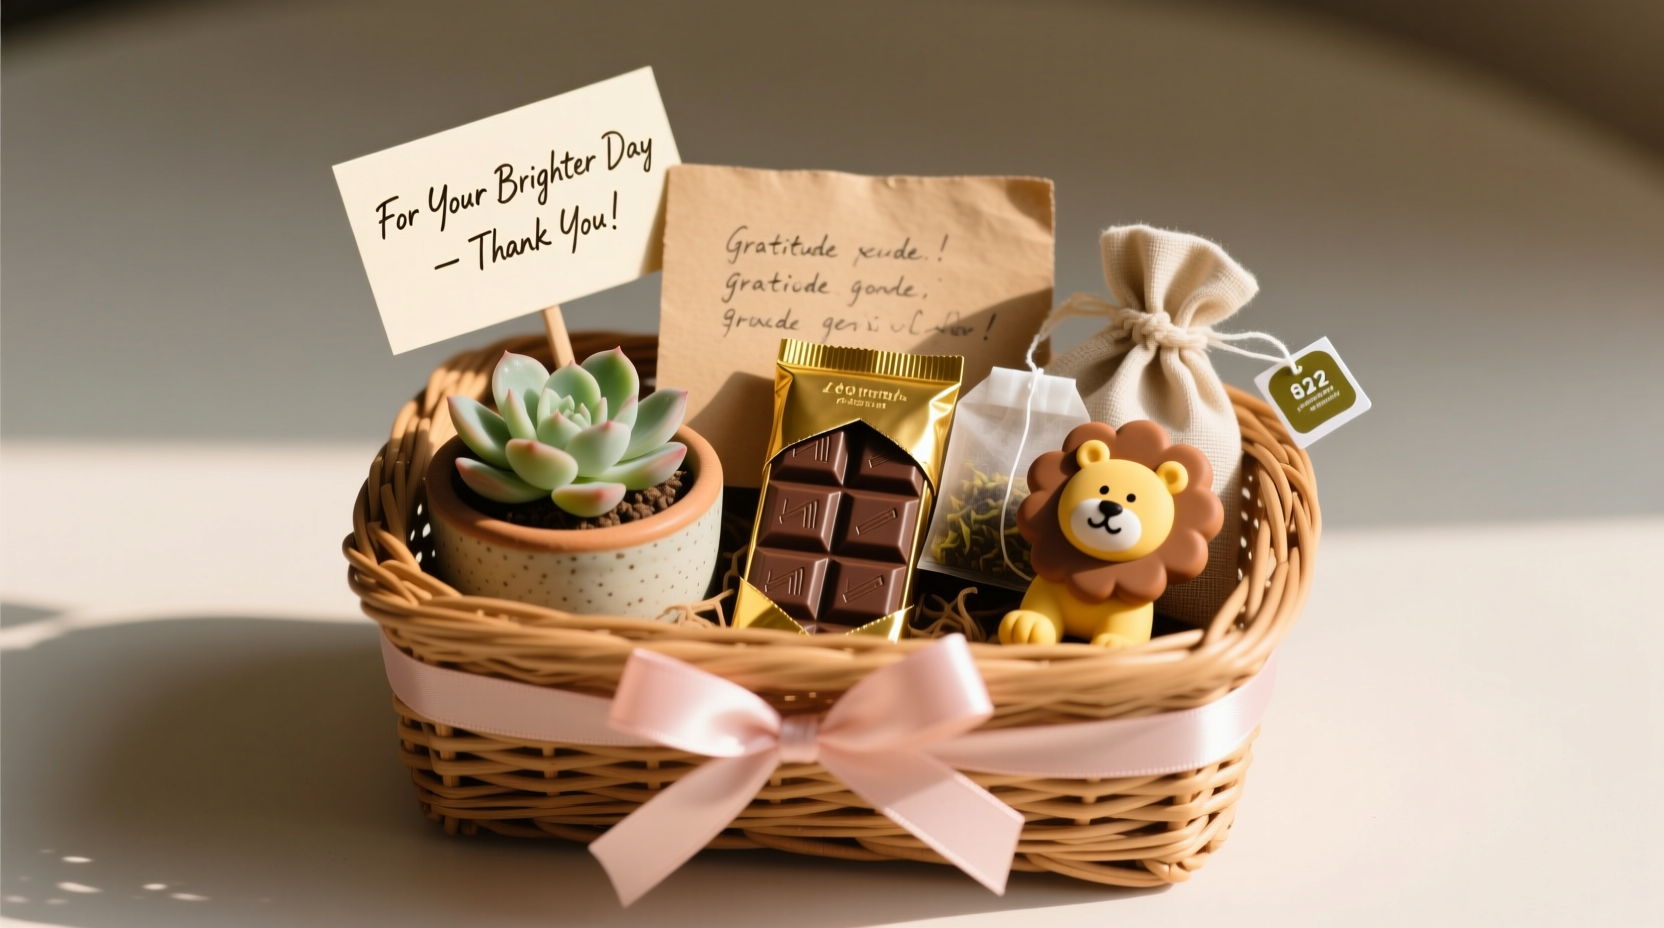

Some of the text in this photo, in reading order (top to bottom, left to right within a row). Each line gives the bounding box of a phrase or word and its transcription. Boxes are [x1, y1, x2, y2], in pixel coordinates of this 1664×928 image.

[375, 130, 653, 240] For Your Brighter Day
[467, 216, 552, 271] Thank
[559, 190, 619, 255] You!
[725, 225, 839, 265] Gratitude
